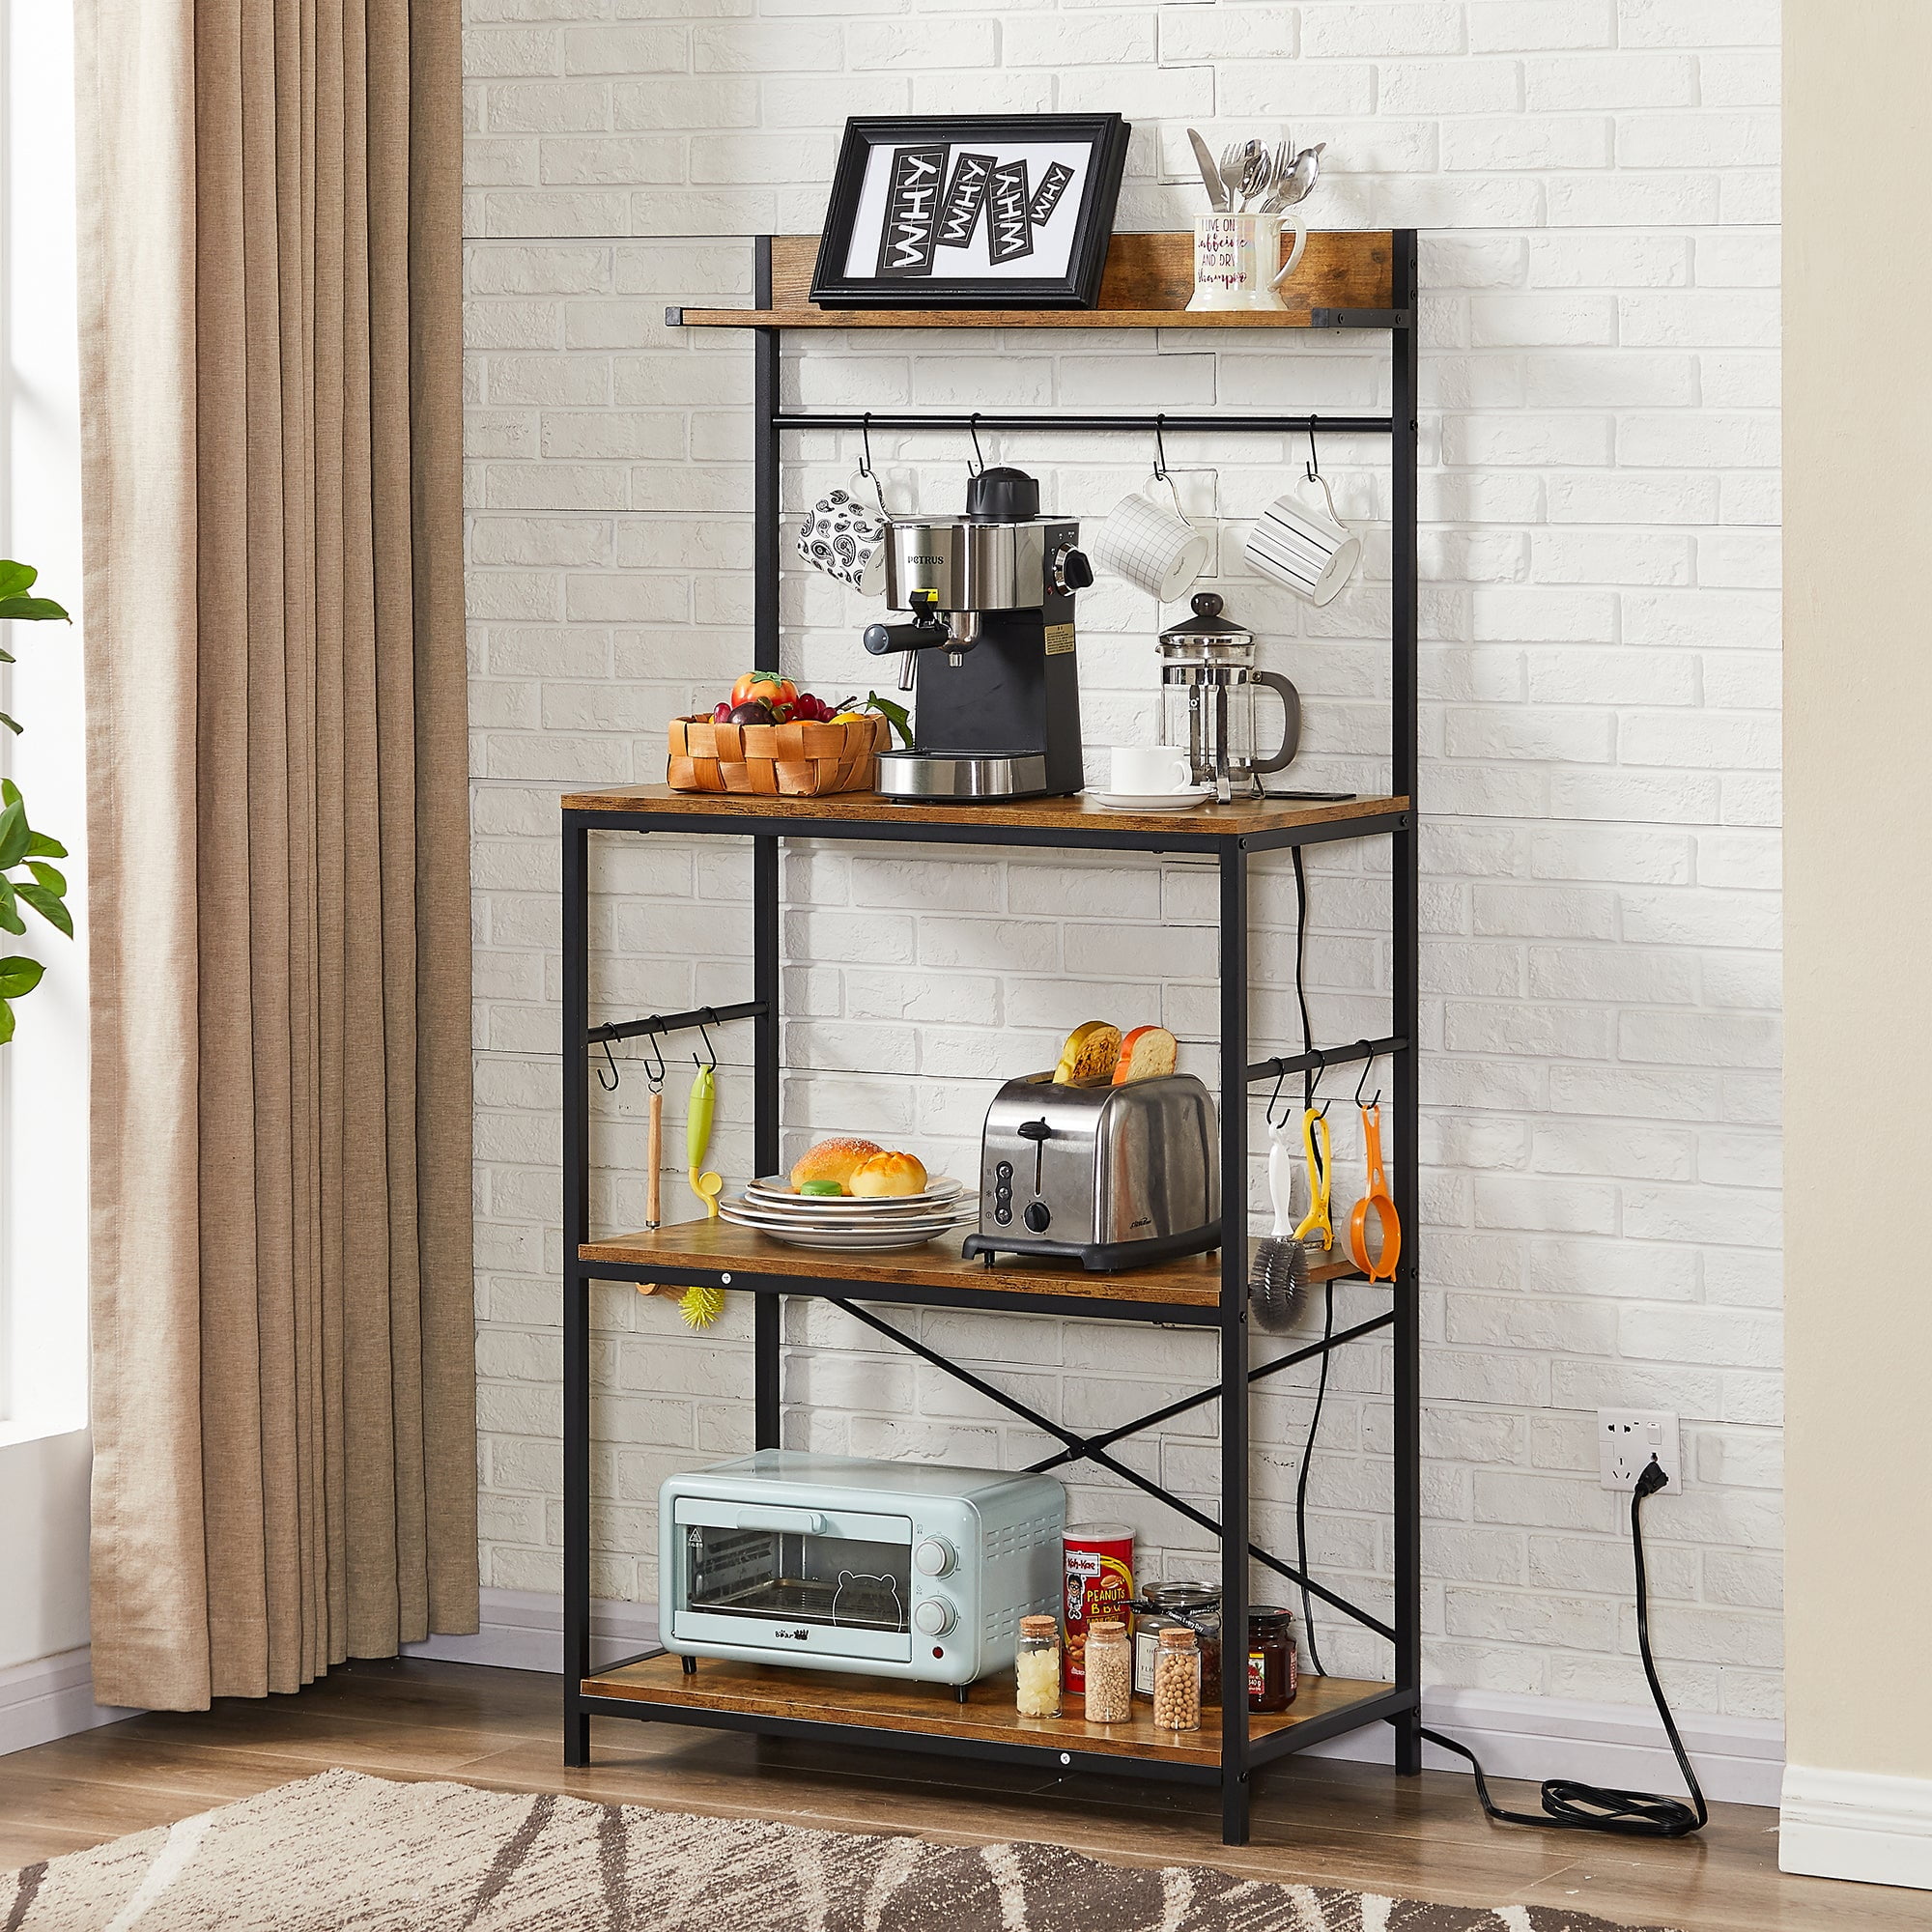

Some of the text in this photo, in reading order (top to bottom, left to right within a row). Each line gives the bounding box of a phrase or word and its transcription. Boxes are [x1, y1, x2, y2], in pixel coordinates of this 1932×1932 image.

[893, 156, 937, 268] WHY
[944, 159, 986, 240] WHY
[994, 172, 1026, 255] WHY
[1031, 167, 1066, 219] WHY
[1206, 218, 1220, 232] LIVE
[1223, 218, 1236, 232] ON
[1202, 253, 1216, 267] AND
[1087, 1587, 1125, 1603] PEANUTS
